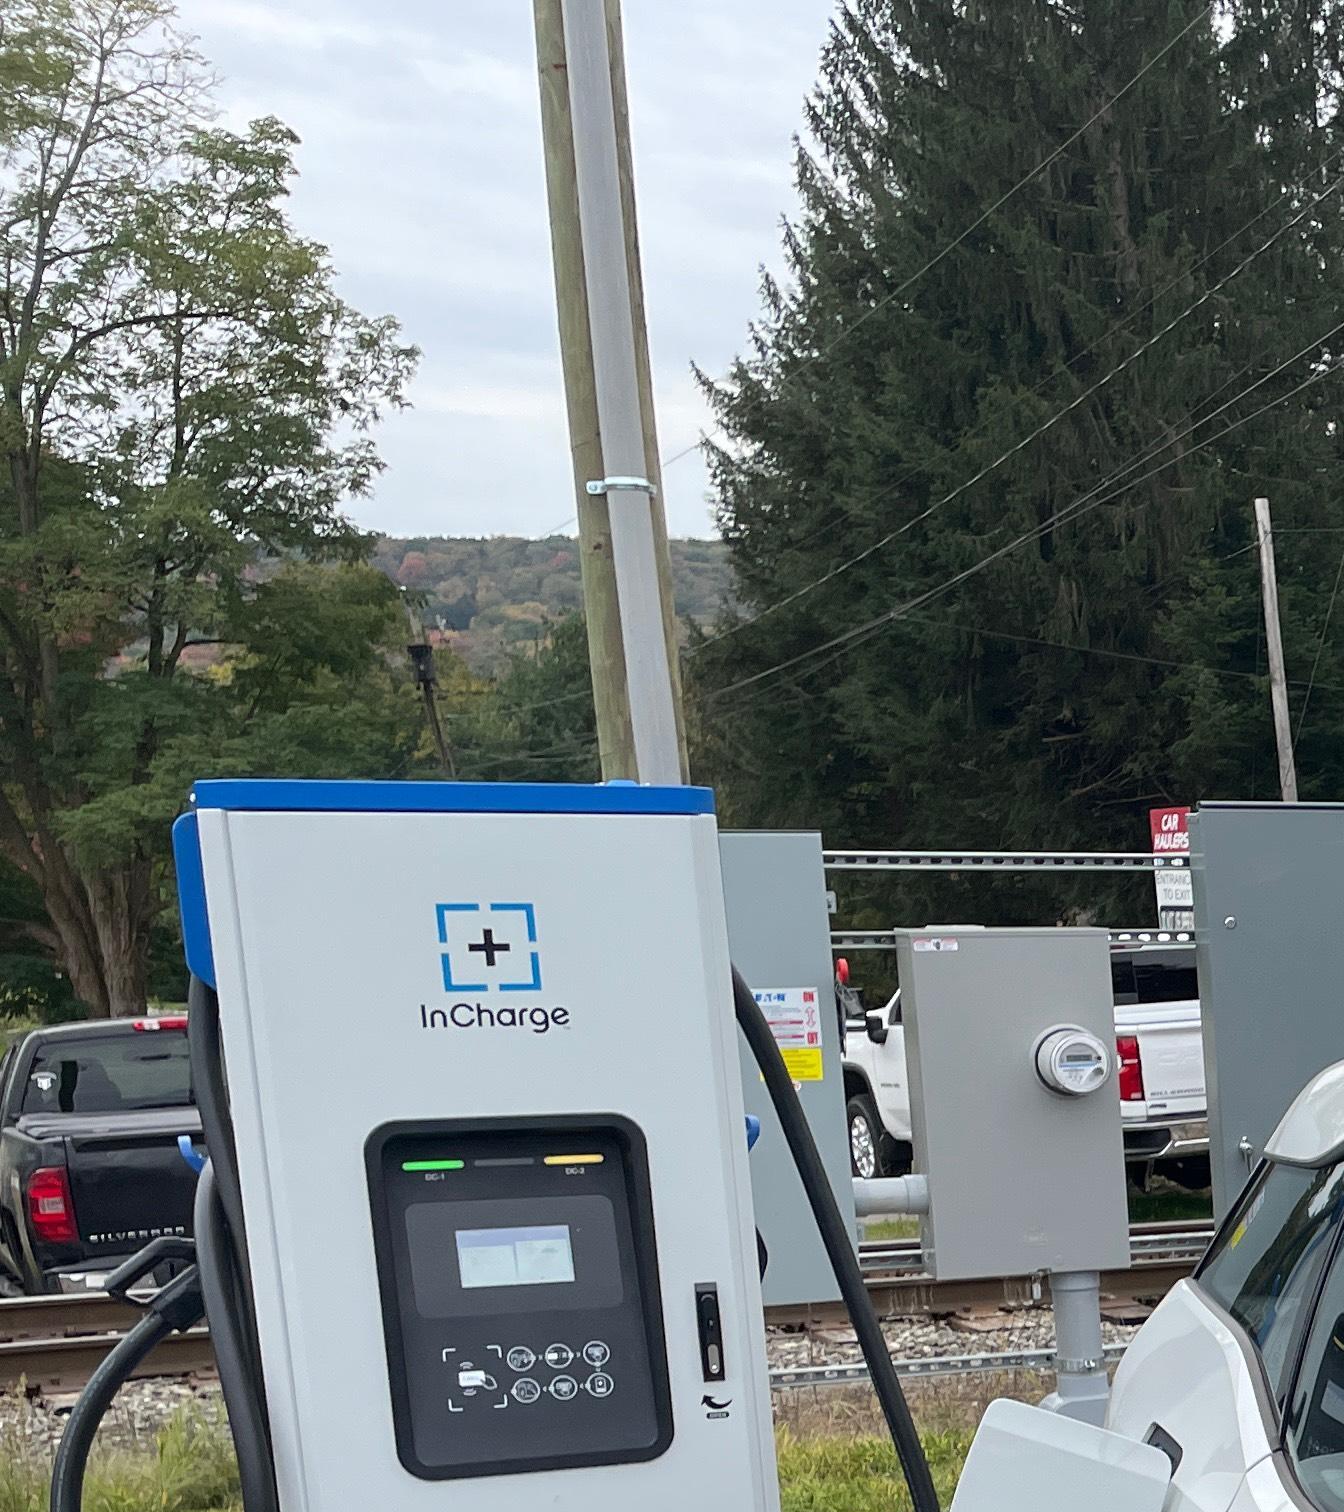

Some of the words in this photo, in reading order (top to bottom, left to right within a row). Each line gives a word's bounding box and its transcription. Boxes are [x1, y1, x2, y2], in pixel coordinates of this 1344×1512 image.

[1160, 813, 1179, 832] CAR
[1153, 832, 1190, 850] HAULERS
[1156, 873, 1191, 886] ENTRANC
[1163, 888, 1174, 900] TO
[1174, 888, 1191, 900] EXIT
[420, 1002, 570, 1034] InCharge
